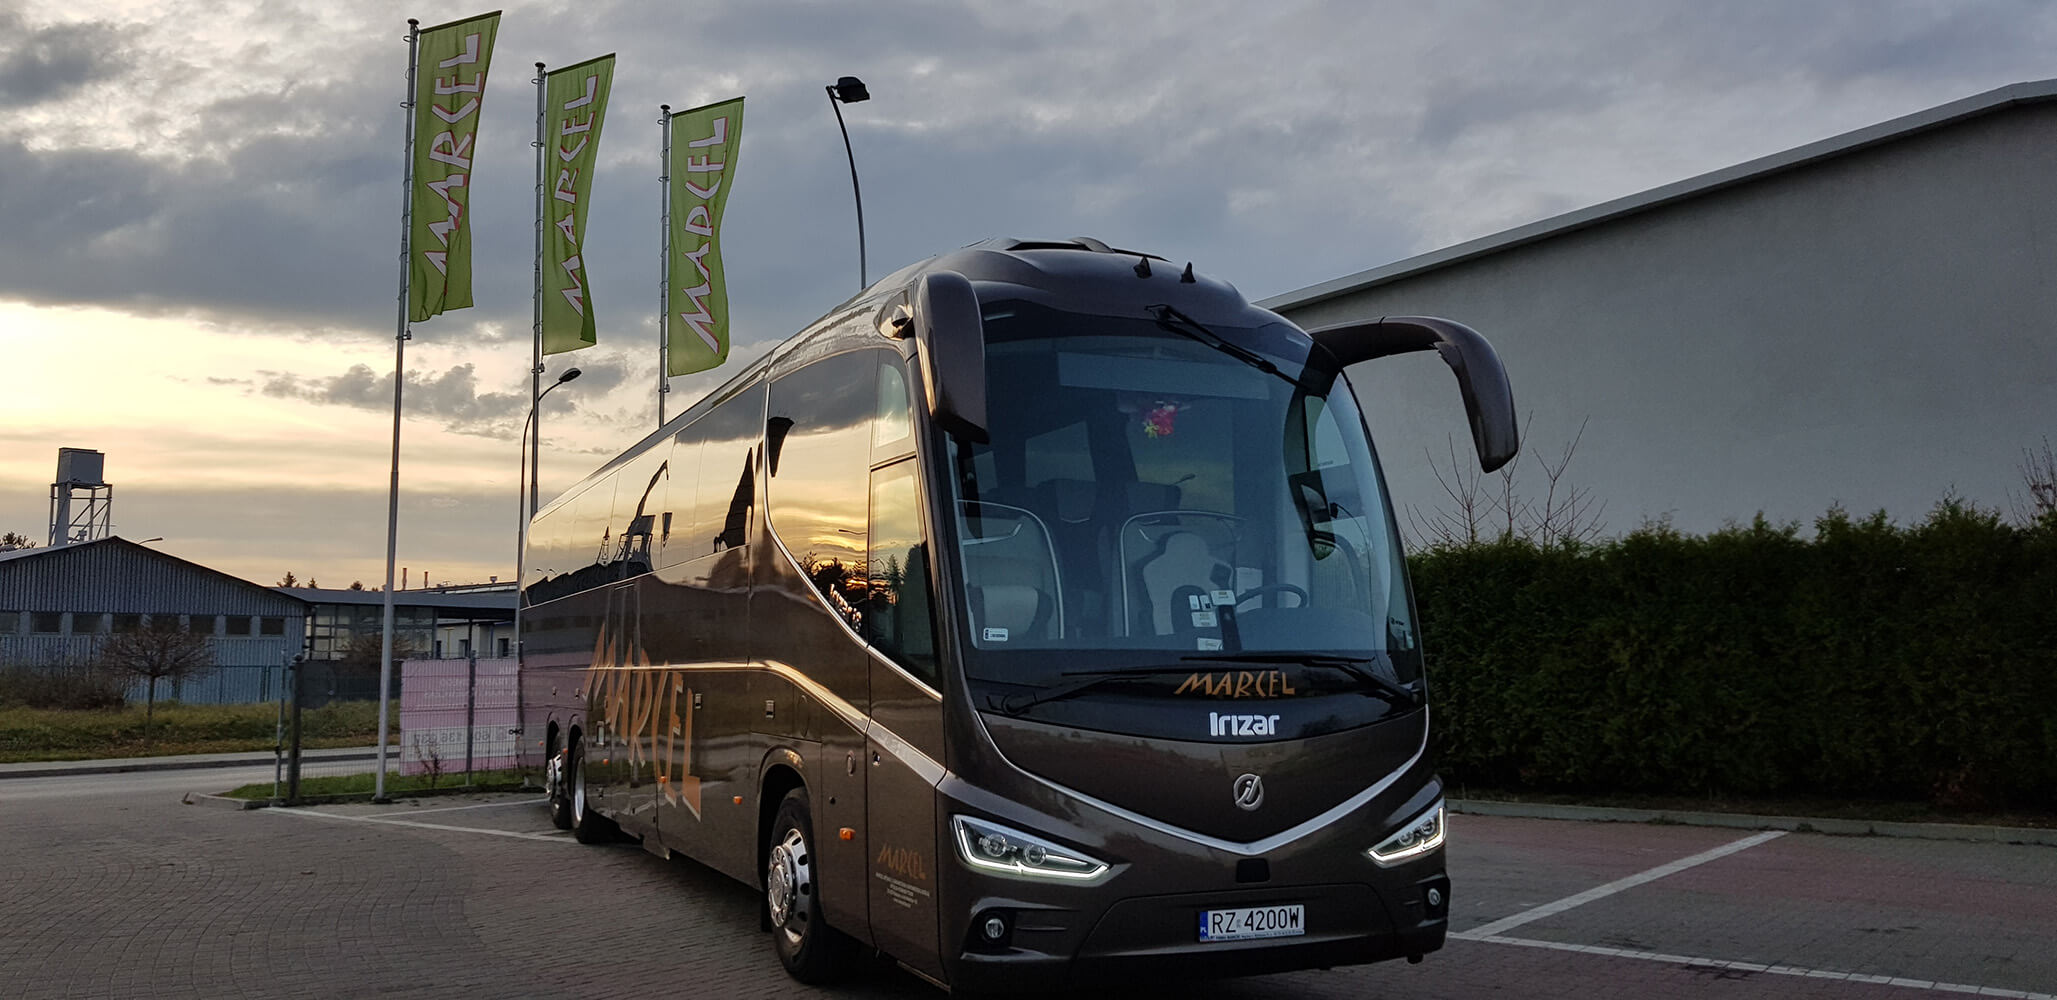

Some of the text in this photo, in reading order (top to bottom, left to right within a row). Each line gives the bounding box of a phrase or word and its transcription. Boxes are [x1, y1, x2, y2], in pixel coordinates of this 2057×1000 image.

[681, 116, 729, 355] MARCEL
[1173, 670, 1296, 698] MARCEL
[582, 622, 702, 823] MARCEL
[1210, 712, 1281, 736] Irizar
[877, 843, 927, 880] MARCEL
[1212, 908, 1300, 934] RZ 4200W
